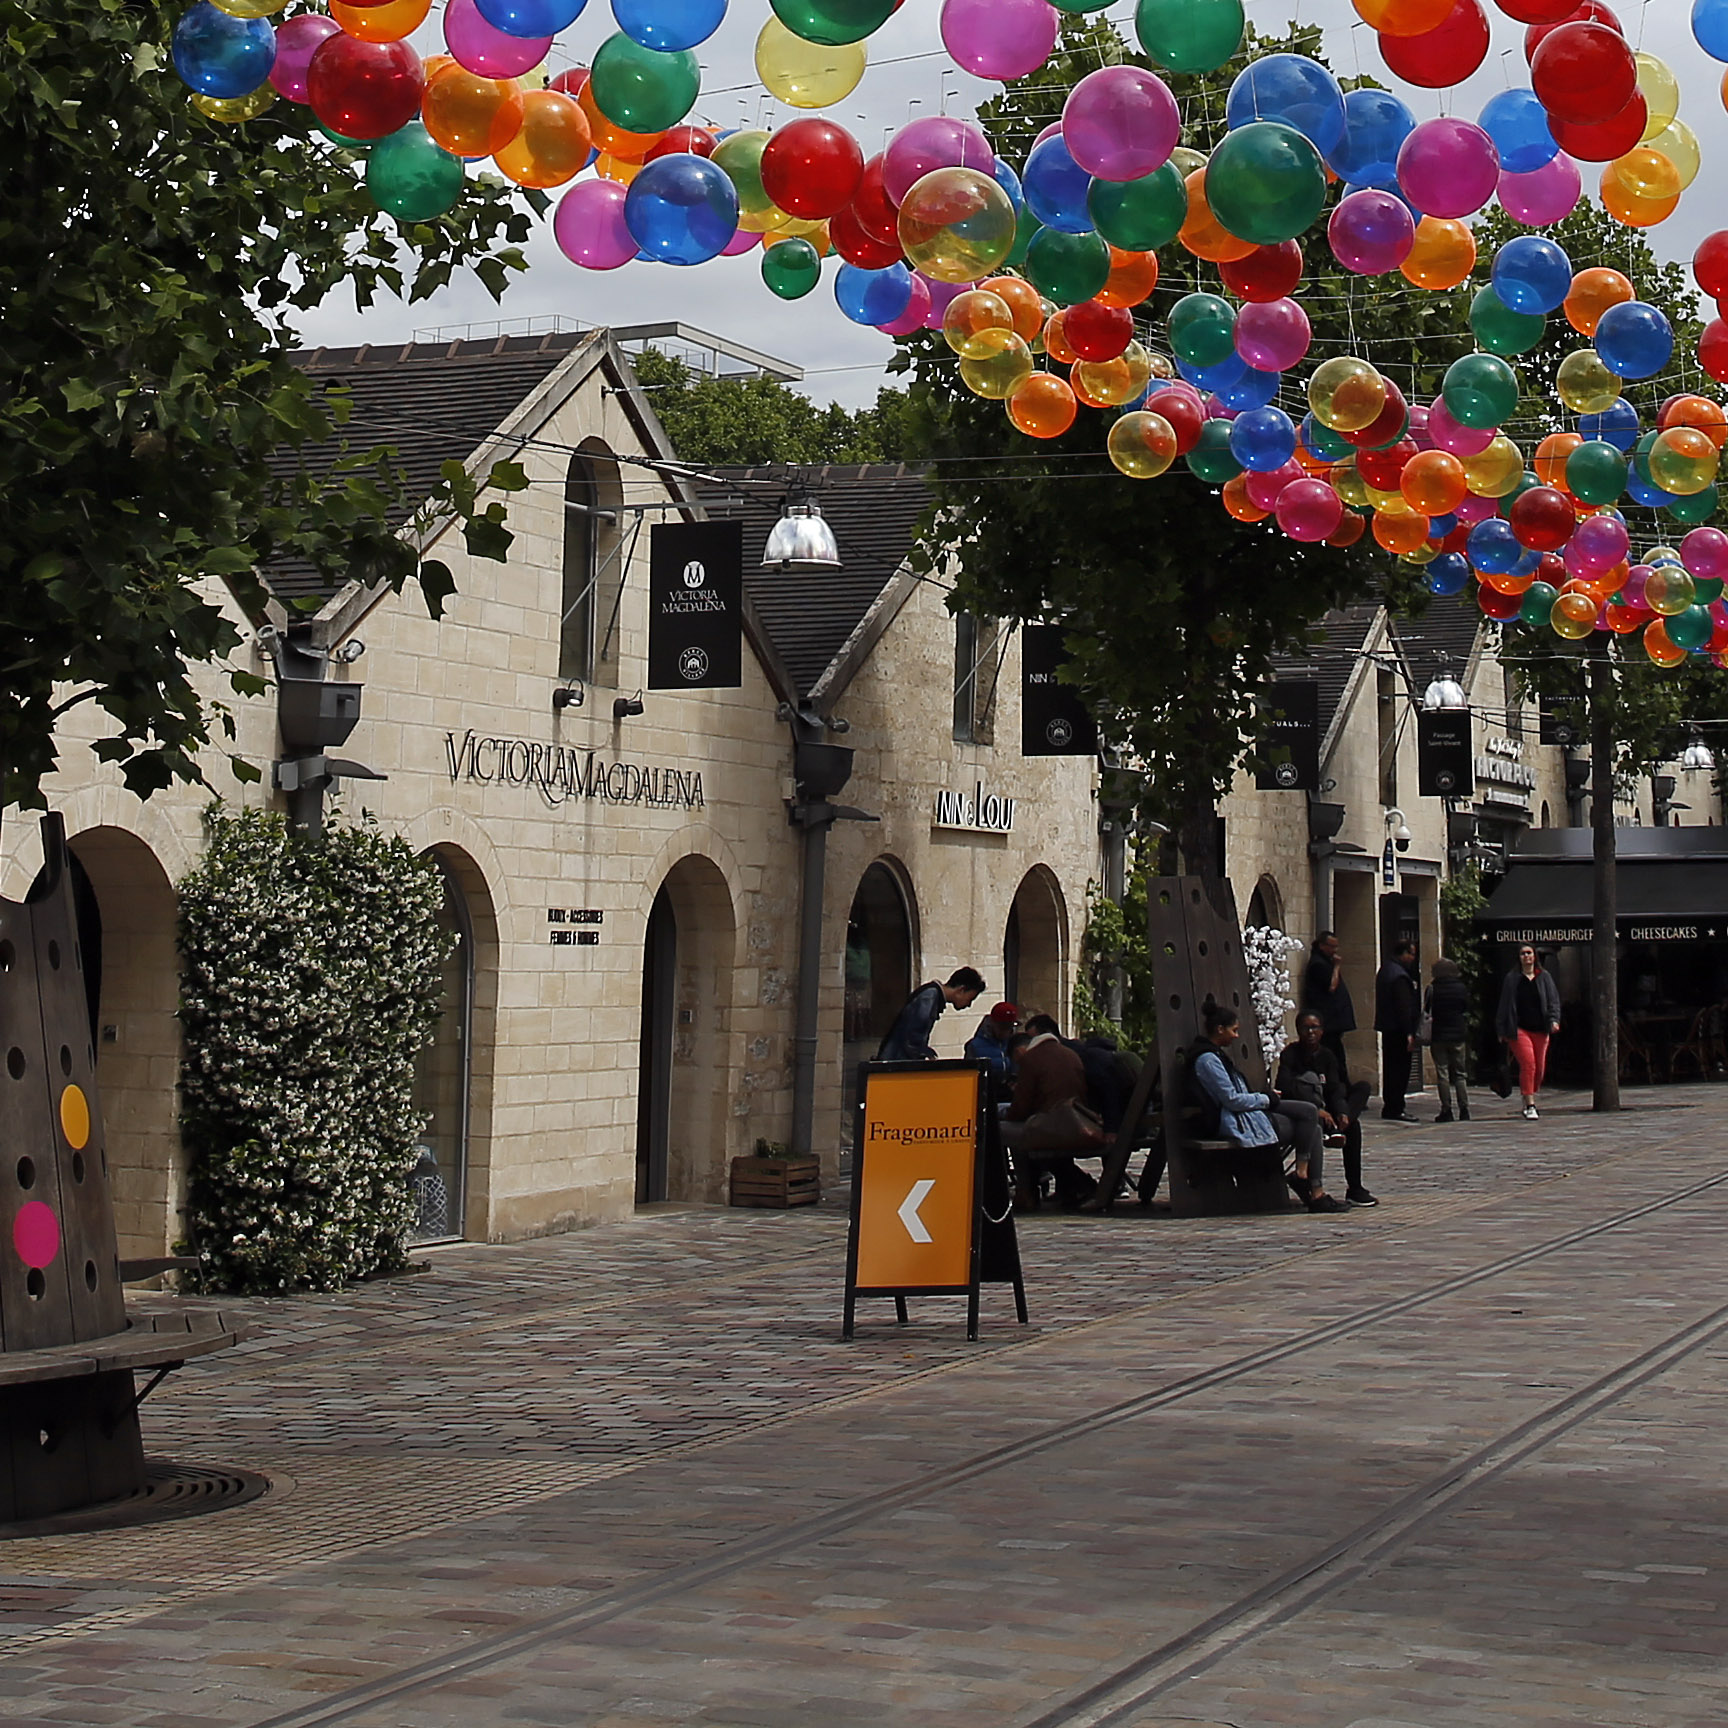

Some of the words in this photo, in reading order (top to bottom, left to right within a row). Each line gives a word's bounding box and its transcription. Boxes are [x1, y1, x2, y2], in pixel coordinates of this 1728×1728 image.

[669, 589, 719, 602] VICTORIA
[662, 601, 726, 613] MAGDALENA
[1029, 673, 1048, 683] NIN
[1496, 930, 1534, 942] GRILLED
[1630, 927, 1697, 939] CHEESECAKES
[868, 1118, 971, 1146] Fragonard
